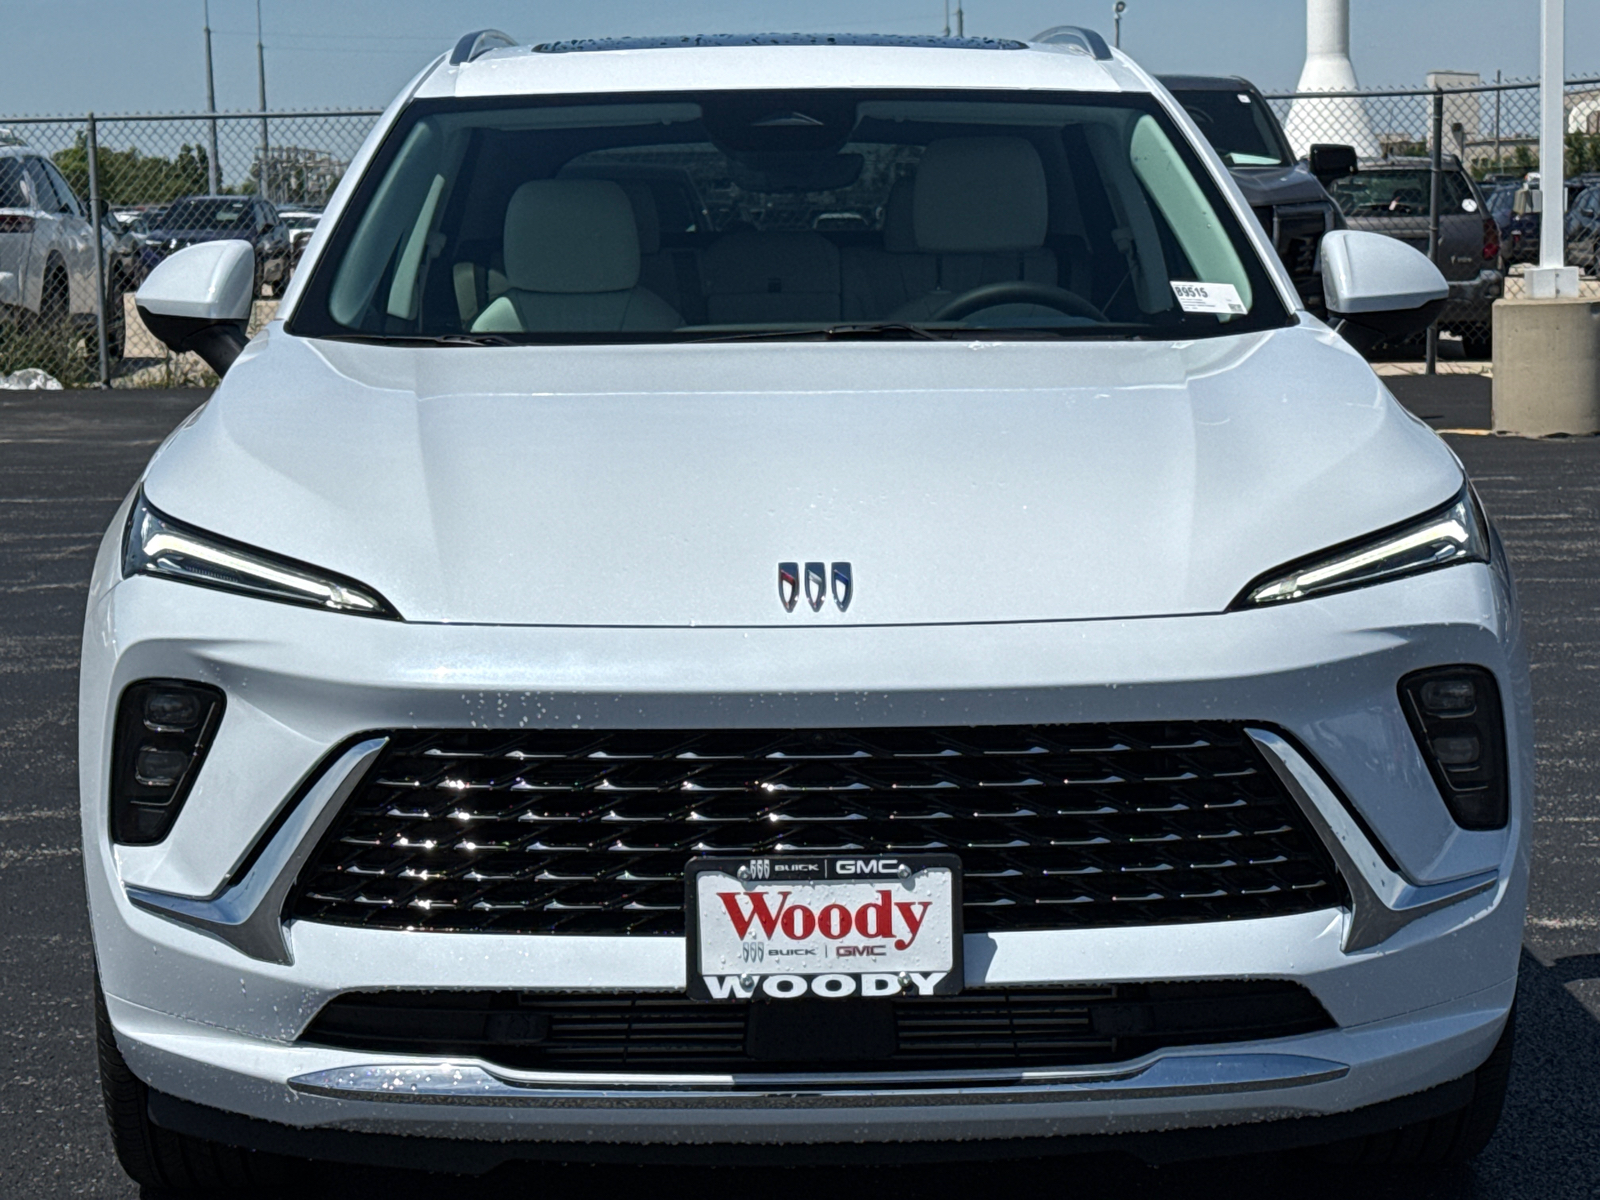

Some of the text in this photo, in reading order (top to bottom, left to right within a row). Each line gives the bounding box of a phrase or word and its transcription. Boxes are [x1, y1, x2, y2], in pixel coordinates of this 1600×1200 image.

[836, 860, 898, 874] GMC
[716, 890, 933, 951] Woody
[768, 945, 887, 957] BUICK GMC
[703, 972, 948, 1000] WOODY
